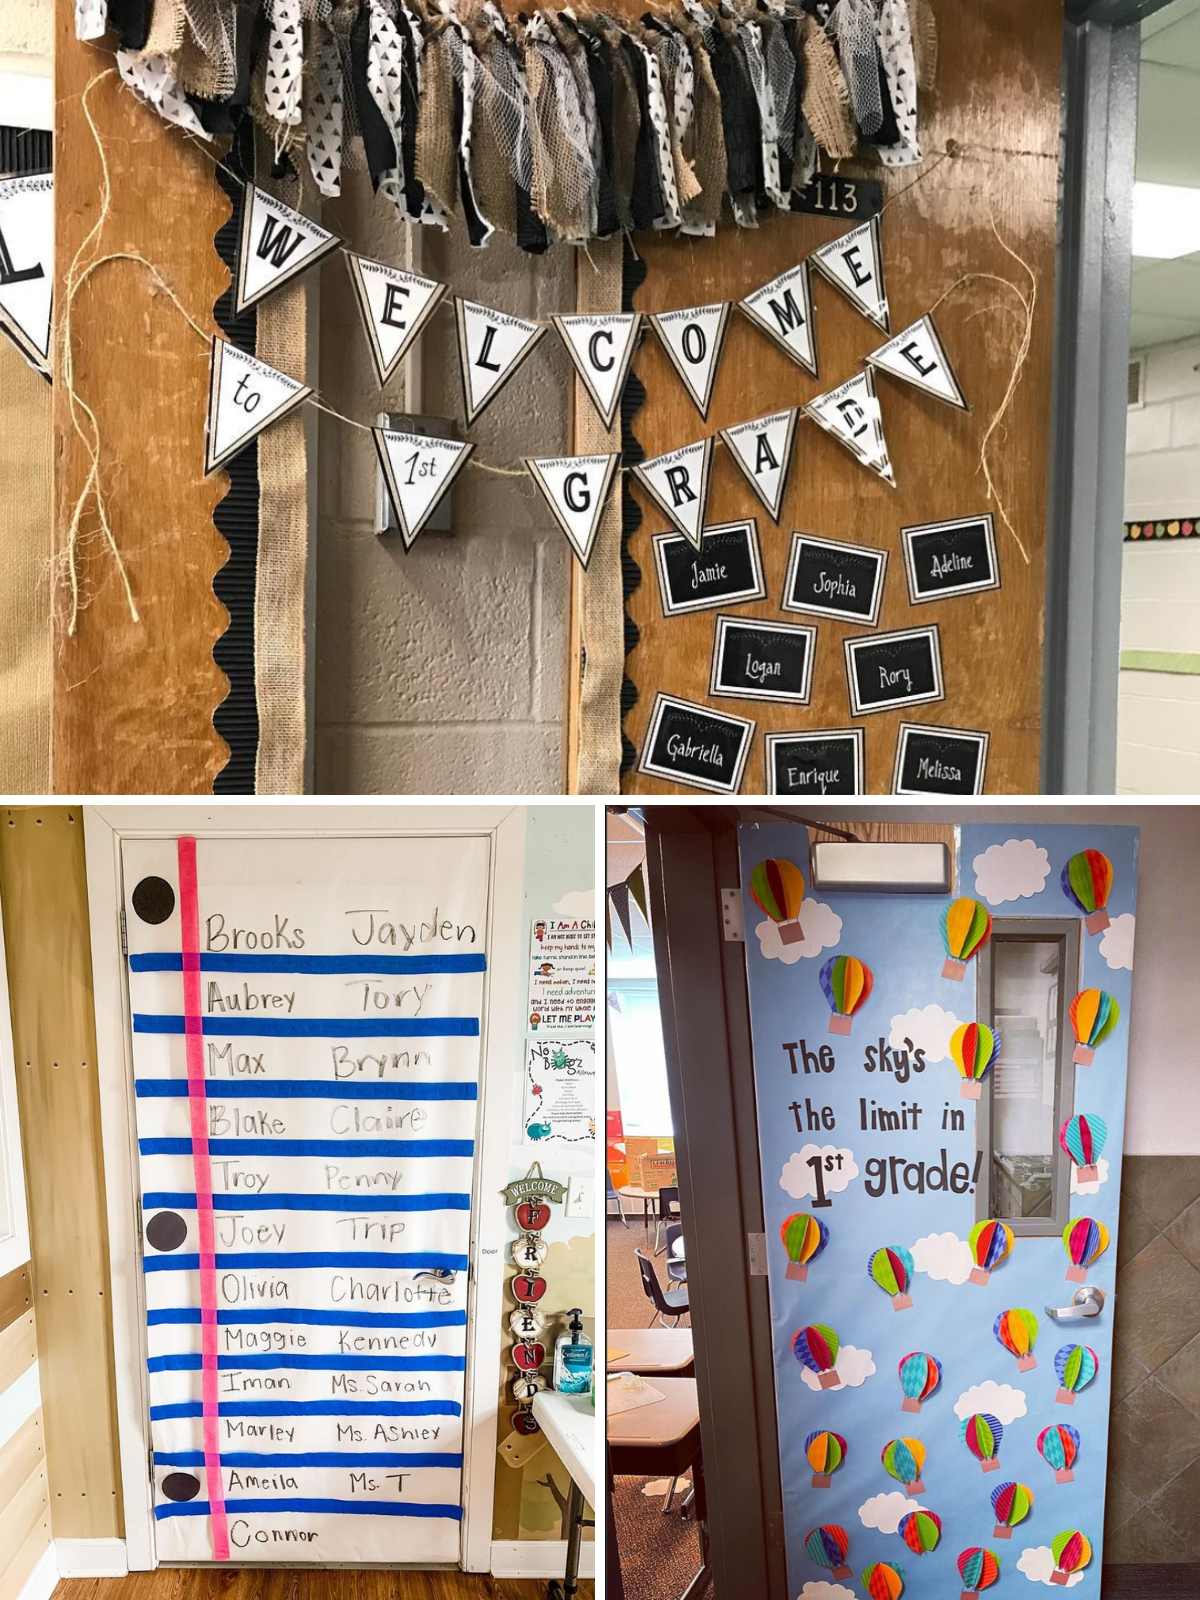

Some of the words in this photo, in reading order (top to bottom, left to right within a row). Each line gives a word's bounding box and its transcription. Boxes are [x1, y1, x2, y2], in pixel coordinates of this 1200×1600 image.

[813, 180, 858, 213] 113
[254, 212, 873, 373] WELCOME
[231, 373, 262, 413] to
[404, 449, 438, 486] 1st
[691, 561, 729, 588] Jamie
[929, 554, 974, 579] Adeline
[813, 571, 856, 598] Sophia
[745, 653, 781, 683] Logan
[879, 666, 913, 692] Rory
[666, 734, 724, 767] Gabriella
[788, 767, 840, 794] Enrique
[916, 757, 962, 781] Melissa
[206, 913, 305, 952] Brooks
[345, 906, 476, 951] Jayden
[550, 921, 555, 929] I
[557, 921, 570, 930] Am
[207, 980, 296, 1013] Aubrey
[344, 979, 433, 1016] Tory
[542, 1014, 557, 1023] LET
[574, 1014, 595, 1023] PLAY
[207, 1042, 267, 1077] Max
[782, 1039, 836, 1074] The
[864, 1037, 926, 1083] sky's
[209, 1104, 287, 1137] Blake
[788, 1098, 836, 1132] the
[859, 1098, 922, 1131] limit
[942, 1101, 965, 1131] in
[212, 1160, 270, 1193] Troy
[324, 1164, 403, 1190] Penny
[511, 1181, 558, 1197] WELCOME
[806, 1153, 844, 1208] 1st
[864, 1148, 983, 1198] grade!
[215, 1215, 287, 1248] Joey
[336, 1216, 406, 1243] Trip
[221, 1273, 290, 1304] Olivia
[330, 1275, 455, 1306] Charlotte
[225, 1326, 307, 1352] Maggie
[222, 1371, 292, 1393] Iman
[366, 1375, 431, 1395] Sarah
[226, 1419, 296, 1443] Marley
[228, 1470, 299, 1492] Ameila
[349, 1472, 380, 1493] Ms.
[386, 1473, 411, 1492] T
[230, 1519, 319, 1548] Connor
